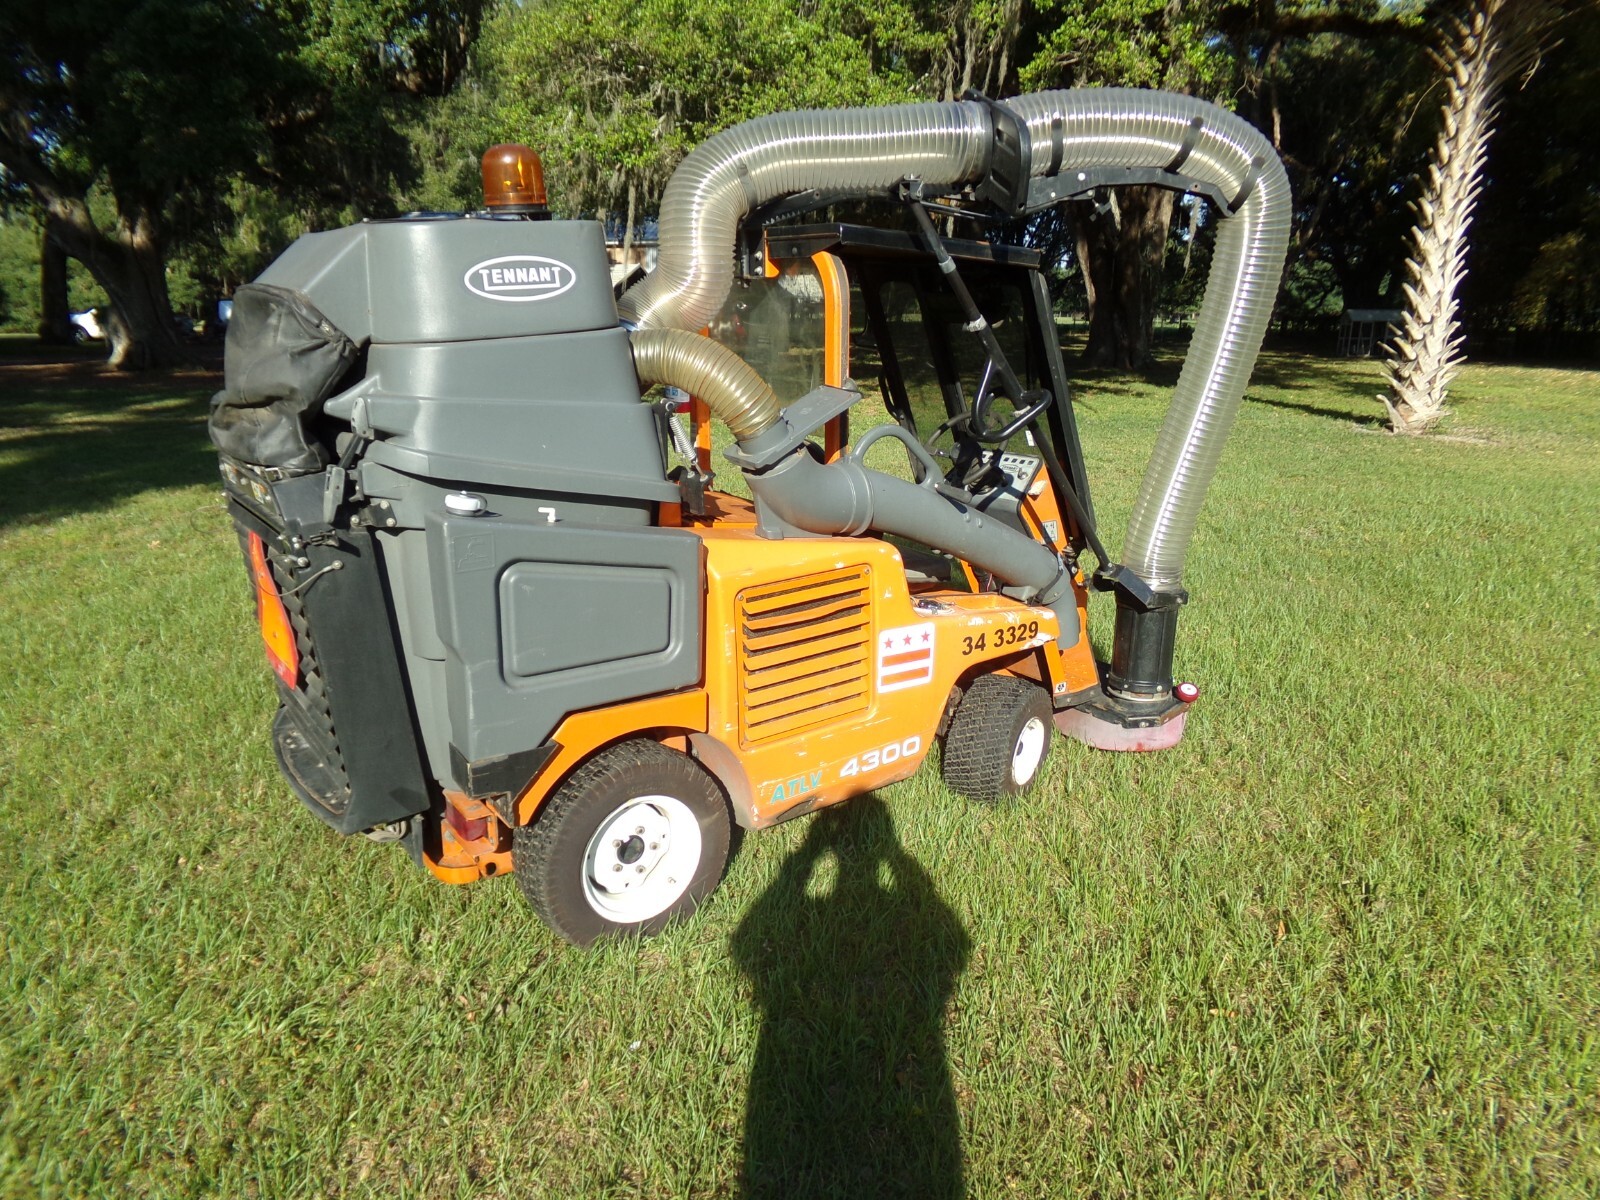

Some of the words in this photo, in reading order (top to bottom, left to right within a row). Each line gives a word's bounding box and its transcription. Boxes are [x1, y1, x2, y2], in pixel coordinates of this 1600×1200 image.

[479, 266, 561, 290] TENNANT
[962, 633, 986, 656] 34
[993, 621, 1039, 648] 3329
[771, 771, 822, 804] ATLV
[839, 736, 921, 778] 4300
